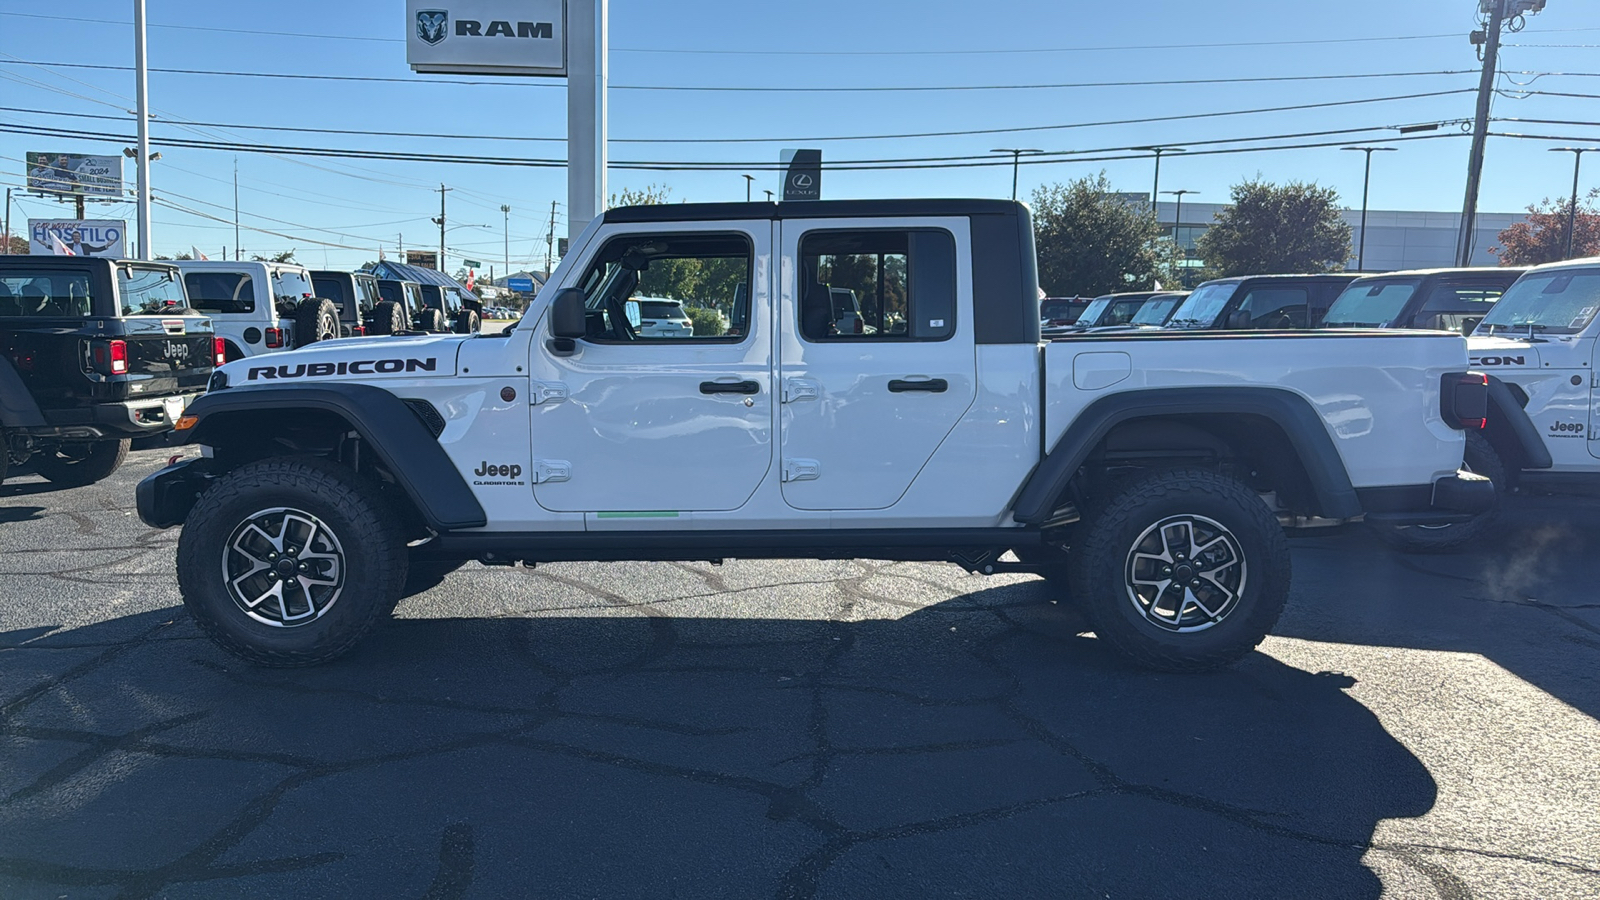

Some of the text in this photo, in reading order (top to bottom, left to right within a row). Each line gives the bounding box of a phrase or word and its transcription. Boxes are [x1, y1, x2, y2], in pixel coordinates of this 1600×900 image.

[455, 20, 553, 39] RAM
[33, 226, 120, 242] HOSTILO
[164, 340, 189, 360] Jeep
[248, 357, 437, 381] RUBICON
[1550, 420, 1584, 434] Jeep
[474, 461, 522, 479] Jeep
